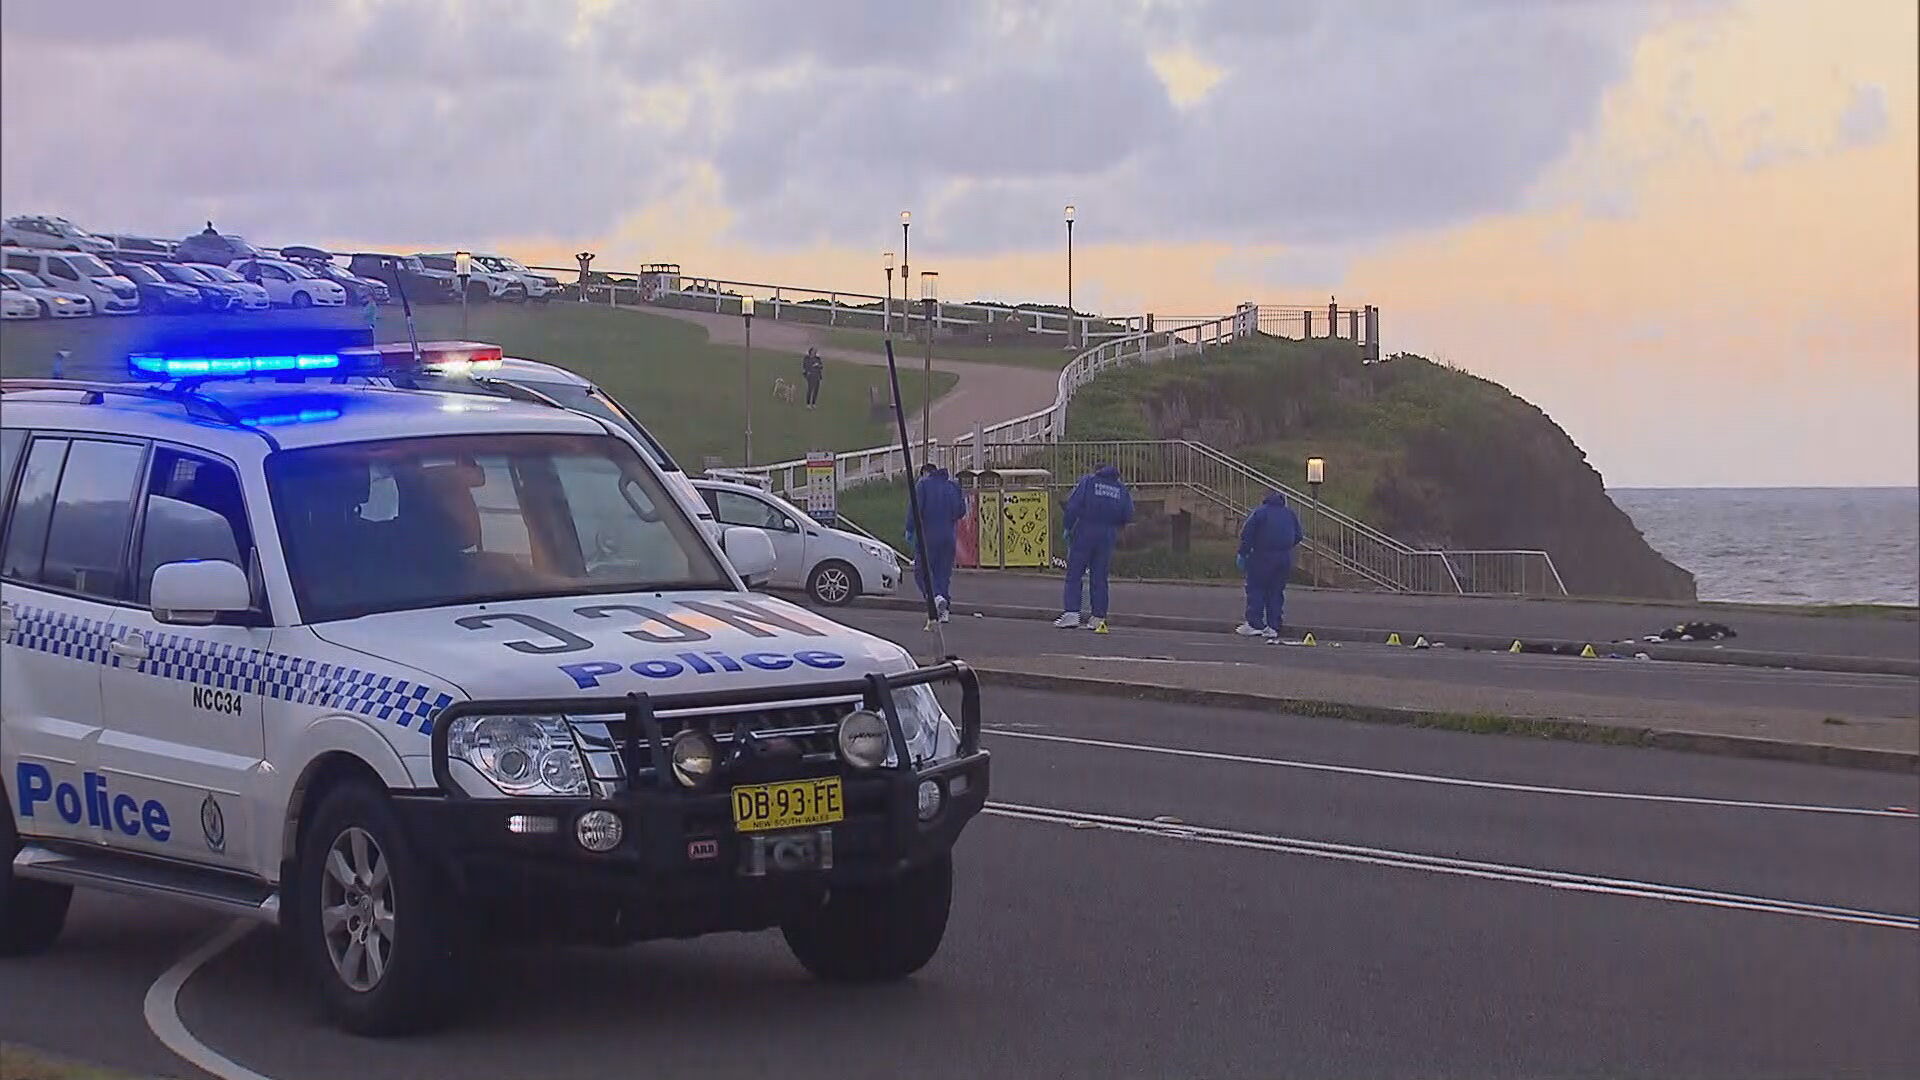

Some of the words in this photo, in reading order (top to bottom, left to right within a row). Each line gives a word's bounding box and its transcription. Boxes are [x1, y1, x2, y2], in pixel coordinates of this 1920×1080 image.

[557, 650, 845, 690] Police
[193, 686, 242, 717] NCC34
[16, 762, 172, 842] Police
[775, 817, 801, 826] SOUTH
